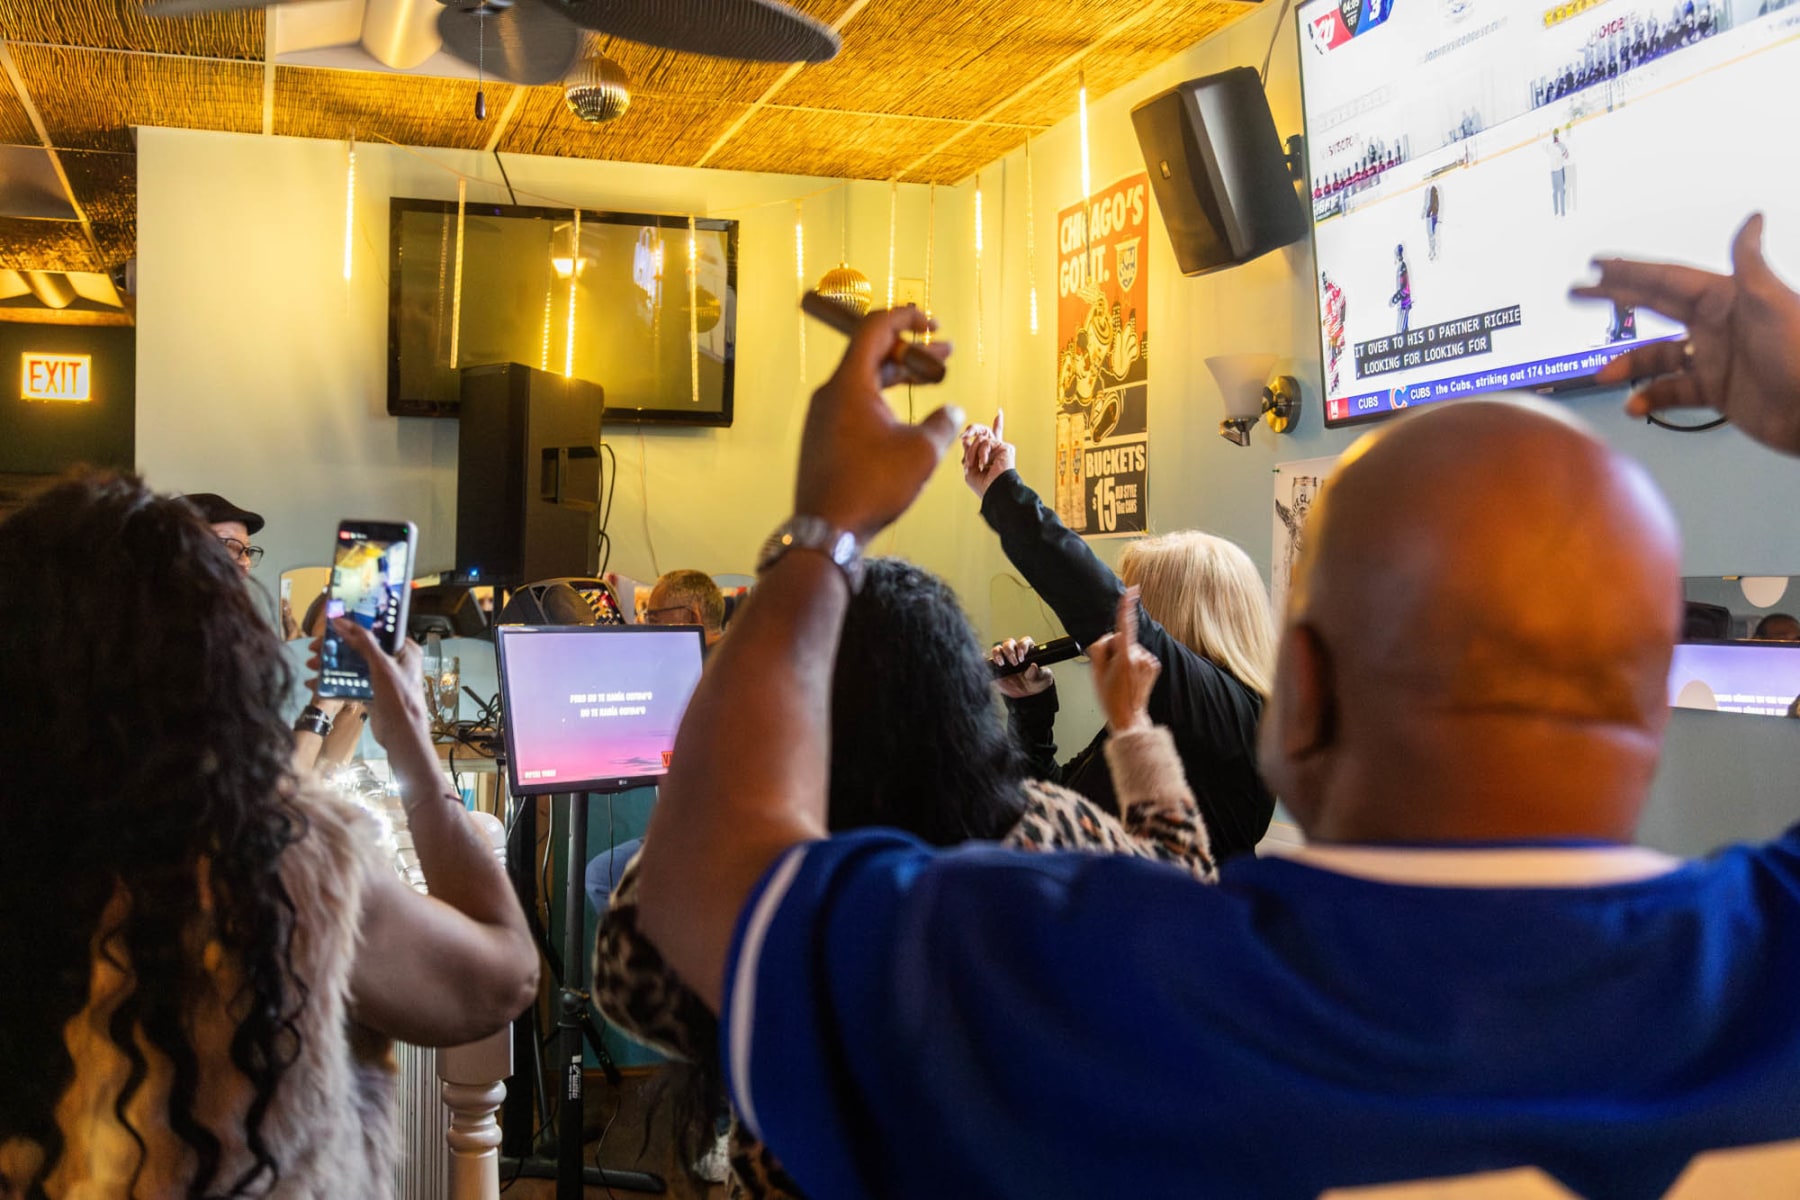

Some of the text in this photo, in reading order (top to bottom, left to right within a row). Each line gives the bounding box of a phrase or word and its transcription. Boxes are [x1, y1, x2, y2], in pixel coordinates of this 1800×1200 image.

[1061, 251, 1088, 298] GOT
[1355, 345, 1364, 358] IT
[1368, 341, 1389, 355] OVER
[1392, 337, 1404, 349] TO
[1407, 332, 1424, 346] HIS
[1439, 318, 1480, 339] PARTNER
[1484, 308, 1521, 329] RICHIE
[1364, 358, 1400, 375] LOOKING
[1404, 353, 1421, 367] FOR
[1424, 342, 1464, 362] LOOKING
[1468, 336, 1488, 352] FOR
[30, 360, 82, 394] EXIT
[1410, 387, 1431, 400] CUBS
[1435, 383, 1448, 395] the
[1450, 379, 1474, 392] Cubs,
[1475, 373, 1508, 389] striking
[1510, 370, 1525, 382] out
[1527, 366, 1543, 379] 174
[1545, 360, 1579, 376] batters
[1581, 354, 1607, 369] while
[1358, 396, 1379, 409] CUBS
[1086, 444, 1145, 478] BUCKETS
